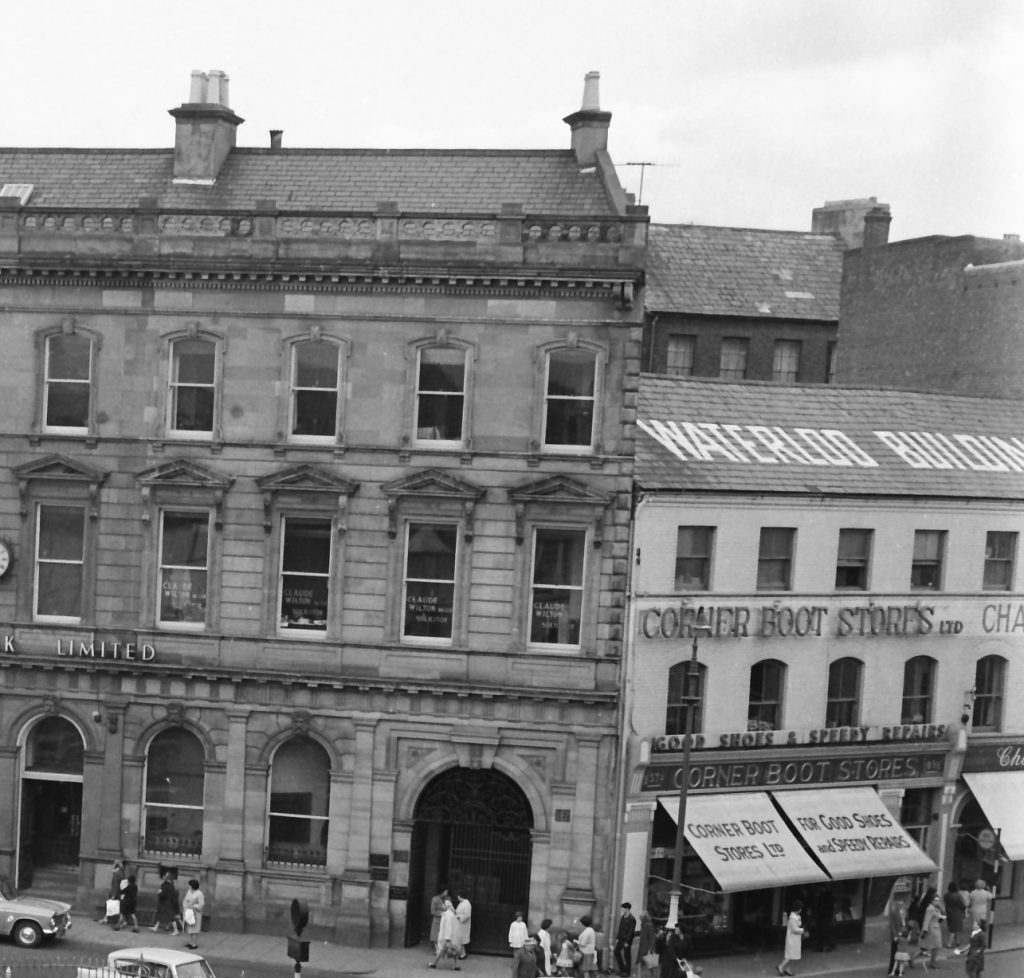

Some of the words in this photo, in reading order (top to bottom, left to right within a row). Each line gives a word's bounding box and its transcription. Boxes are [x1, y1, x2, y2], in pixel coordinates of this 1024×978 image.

[636, 418, 879, 467] WATERLOO
[533, 602, 565, 610] CLAUDE
[760, 606, 828, 637] BOOT
[837, 605, 934, 637] STORES
[939, 620, 964, 635] LTD
[57, 639, 156, 662] LIMITED
[719, 732, 775, 748] SHOES
[766, 761, 830, 785] BOOT
[838, 757, 918, 781] STORES
[687, 823, 744, 838] CORNER
[740, 820, 779, 835] BOOT
[818, 814, 855, 831] GOOD
[852, 813, 893, 828] SHOES
[714, 845, 764, 862] STORES
